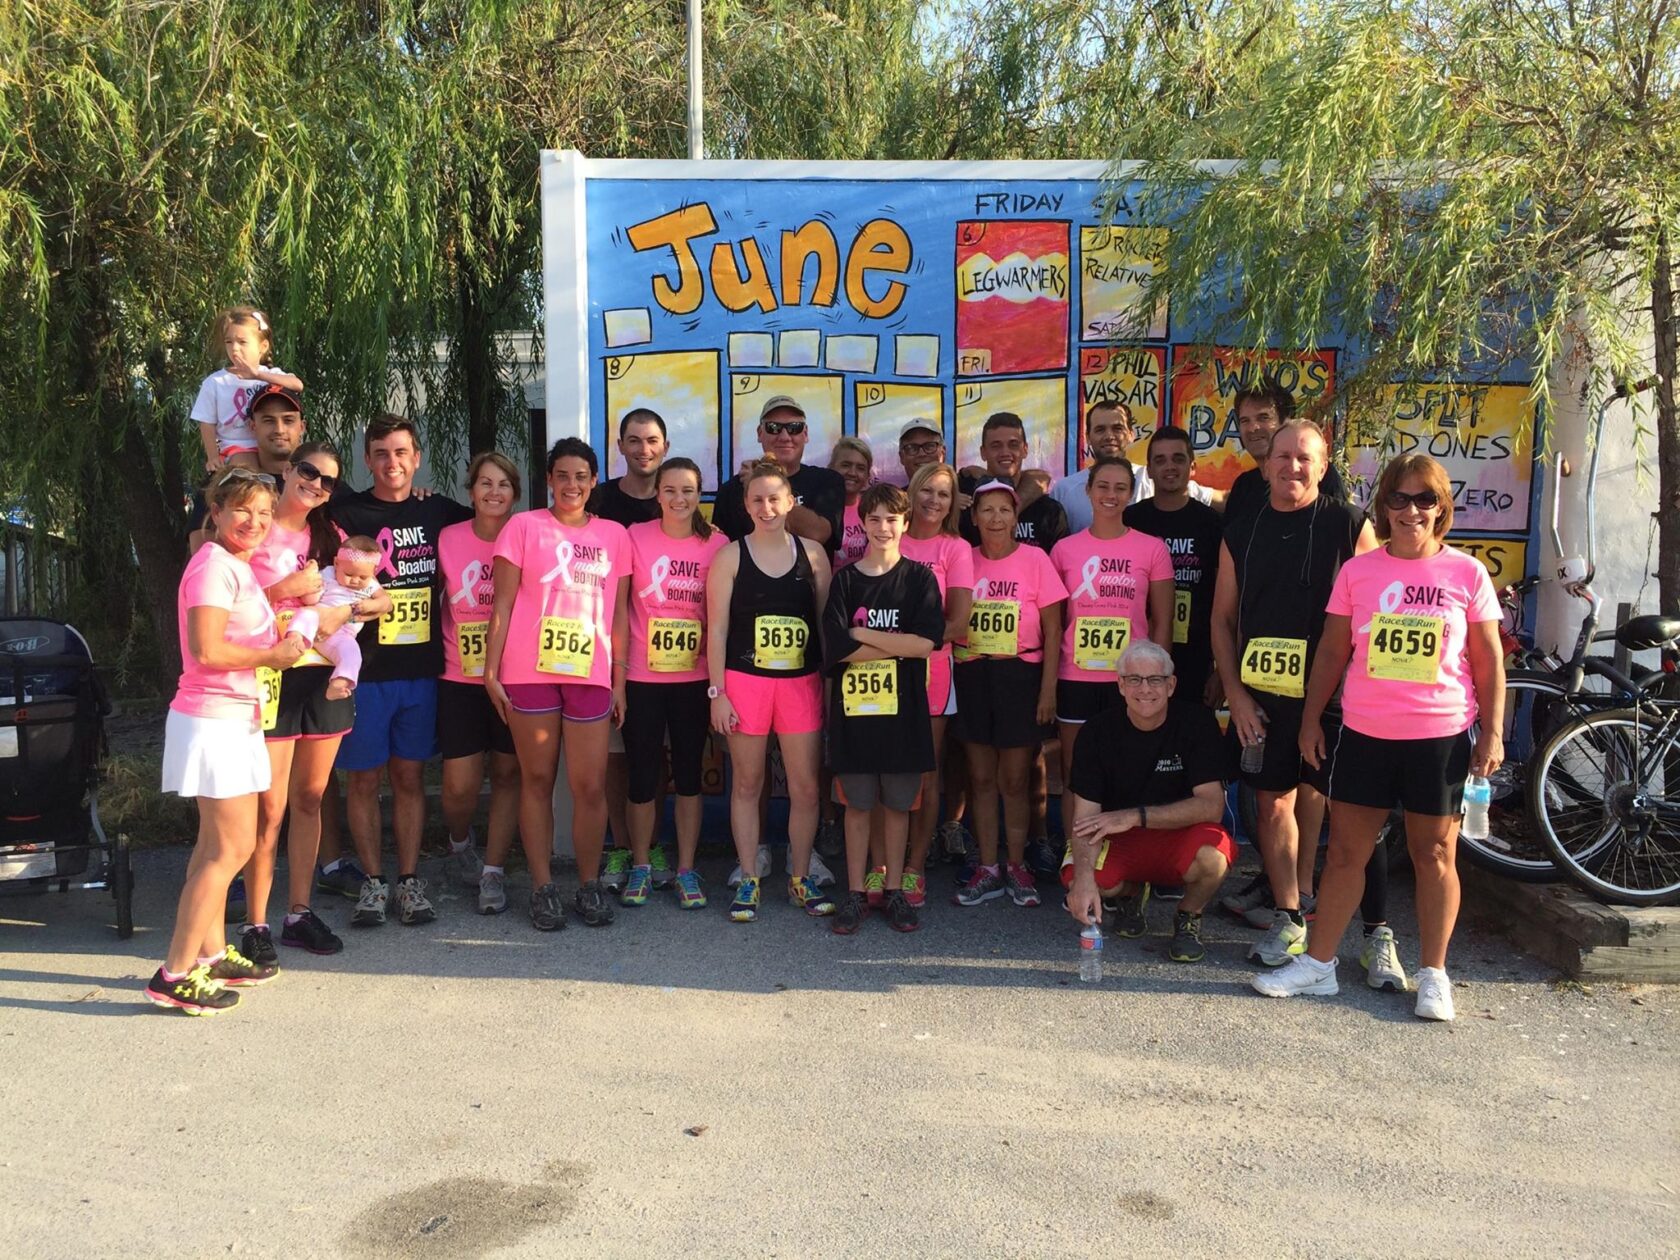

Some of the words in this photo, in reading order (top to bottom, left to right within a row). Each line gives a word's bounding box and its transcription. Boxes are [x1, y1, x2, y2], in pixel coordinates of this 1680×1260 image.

[975, 192, 1064, 215] FRIDAY
[963, 225, 972, 242] 6
[627, 202, 913, 320] June
[961, 264, 1067, 298] LEGWARMERS
[610, 357, 621, 376] 8
[960, 355, 990, 373] FRI.
[1087, 355, 1103, 368] 12
[1110, 350, 1158, 379] PHIL
[865, 387, 880, 402] 10
[1082, 378, 1158, 409] VASSAR
[1428, 430, 1511, 460] ONES
[392, 526, 427, 548] SAVE
[1015, 521, 1035, 539] AVE
[397, 545, 434, 560] motor
[573, 543, 603, 564] SAVE
[1164, 537, 1195, 555] SAVE
[397, 556, 437, 576] Boating
[669, 559, 701, 579] SAVE
[1100, 558, 1133, 575] SAVE
[1174, 566, 1202, 584] ating
[988, 580, 1019, 598] SAVE
[1098, 572, 1137, 588] motor
[667, 588, 704, 604] BOATING
[1099, 585, 1136, 601] BOATING
[1403, 585, 1446, 607] SAVE
[384, 600, 430, 623] 3559
[867, 608, 900, 628] SAVE
[968, 610, 1016, 634] 4660
[1379, 615, 1405, 626] Races
[1416, 619, 1436, 629] Run
[460, 633, 488, 656] 35
[542, 628, 593, 656] 3562
[651, 629, 698, 652] 4646
[759, 626, 806, 649] 3639
[1078, 627, 1127, 650] 3647
[1373, 627, 1437, 658] 4659
[1245, 649, 1301, 677] 4658
[846, 672, 894, 695] 3564
